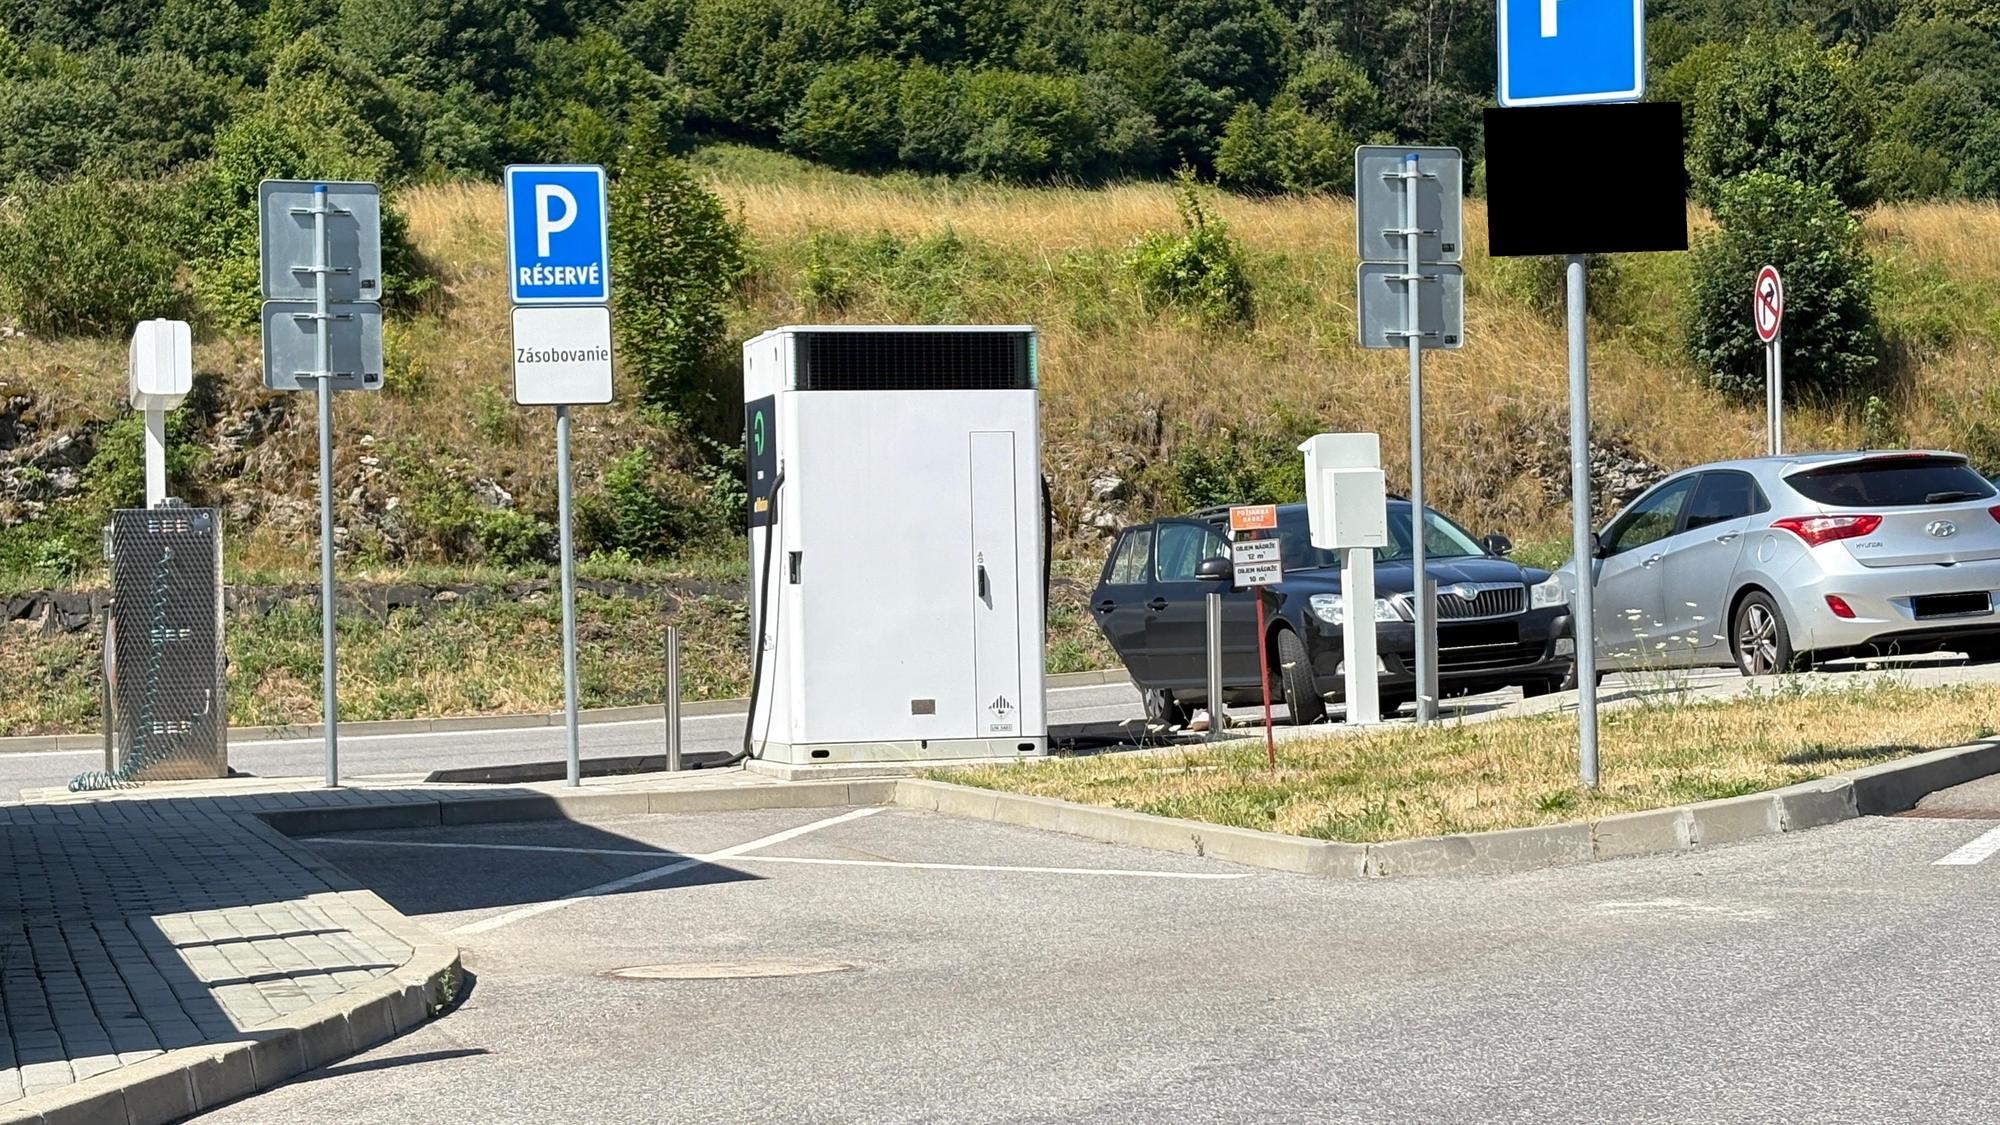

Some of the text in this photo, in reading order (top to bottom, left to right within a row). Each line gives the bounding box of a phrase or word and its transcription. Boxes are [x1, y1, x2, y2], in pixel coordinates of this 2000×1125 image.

[535, 184, 577, 257] P
[520, 262, 599, 286] RÉSERVÉ
[517, 345, 608, 363] Zásobovanie
